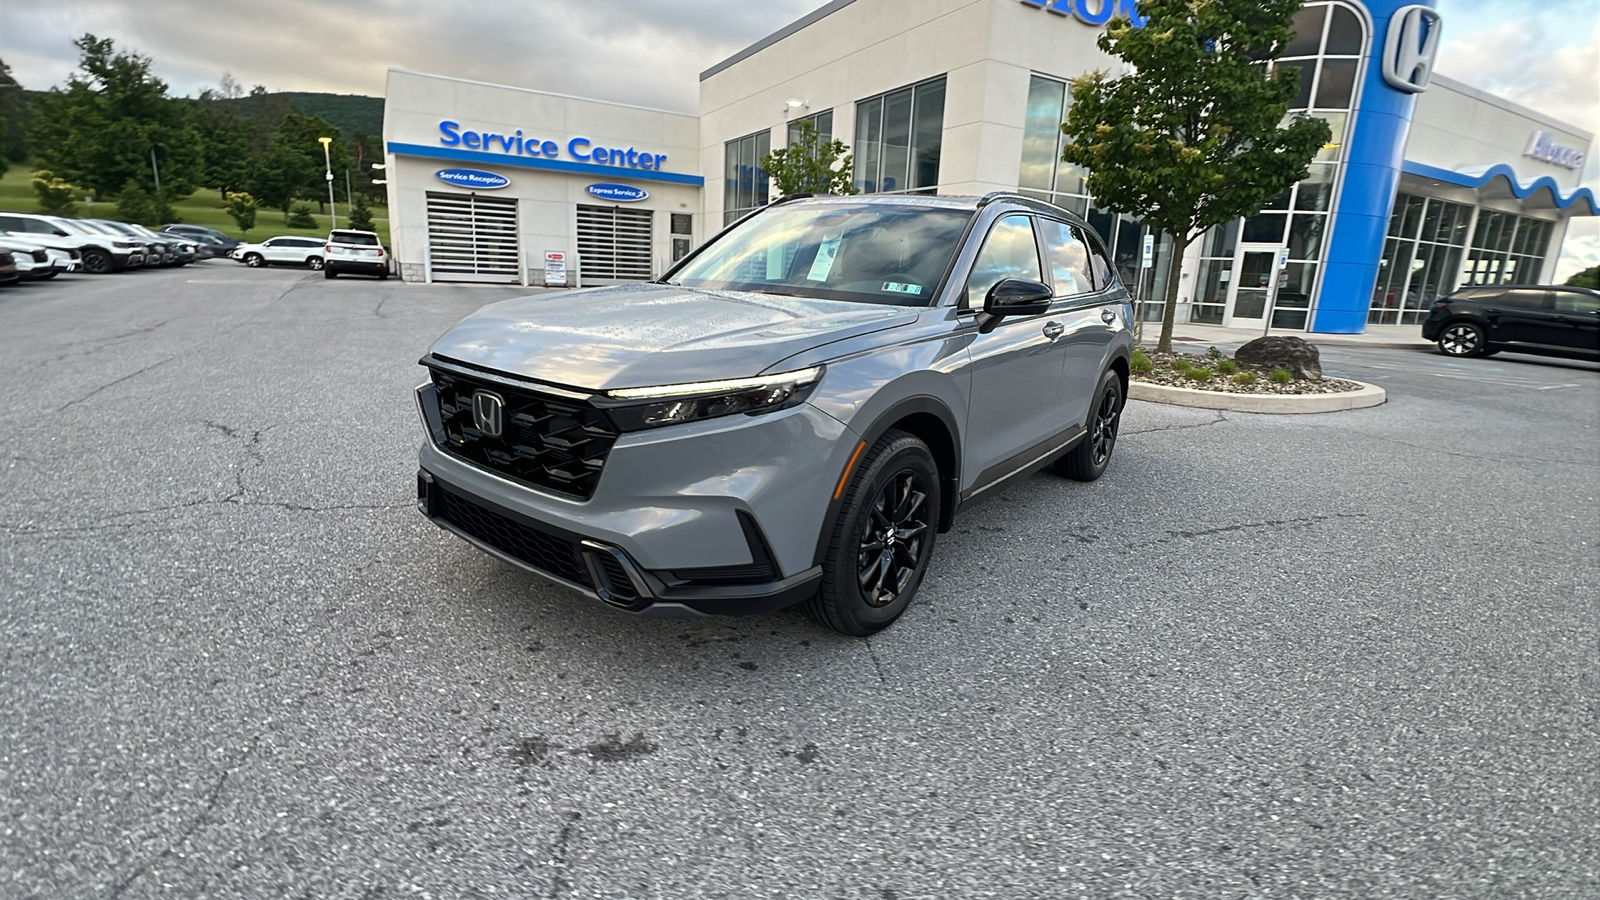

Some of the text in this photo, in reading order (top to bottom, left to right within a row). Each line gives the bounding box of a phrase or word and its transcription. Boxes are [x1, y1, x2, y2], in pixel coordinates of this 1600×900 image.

[439, 120, 667, 171] Service Center
[439, 171, 506, 184] Service Reception
[589, 186, 636, 197] Express Service
